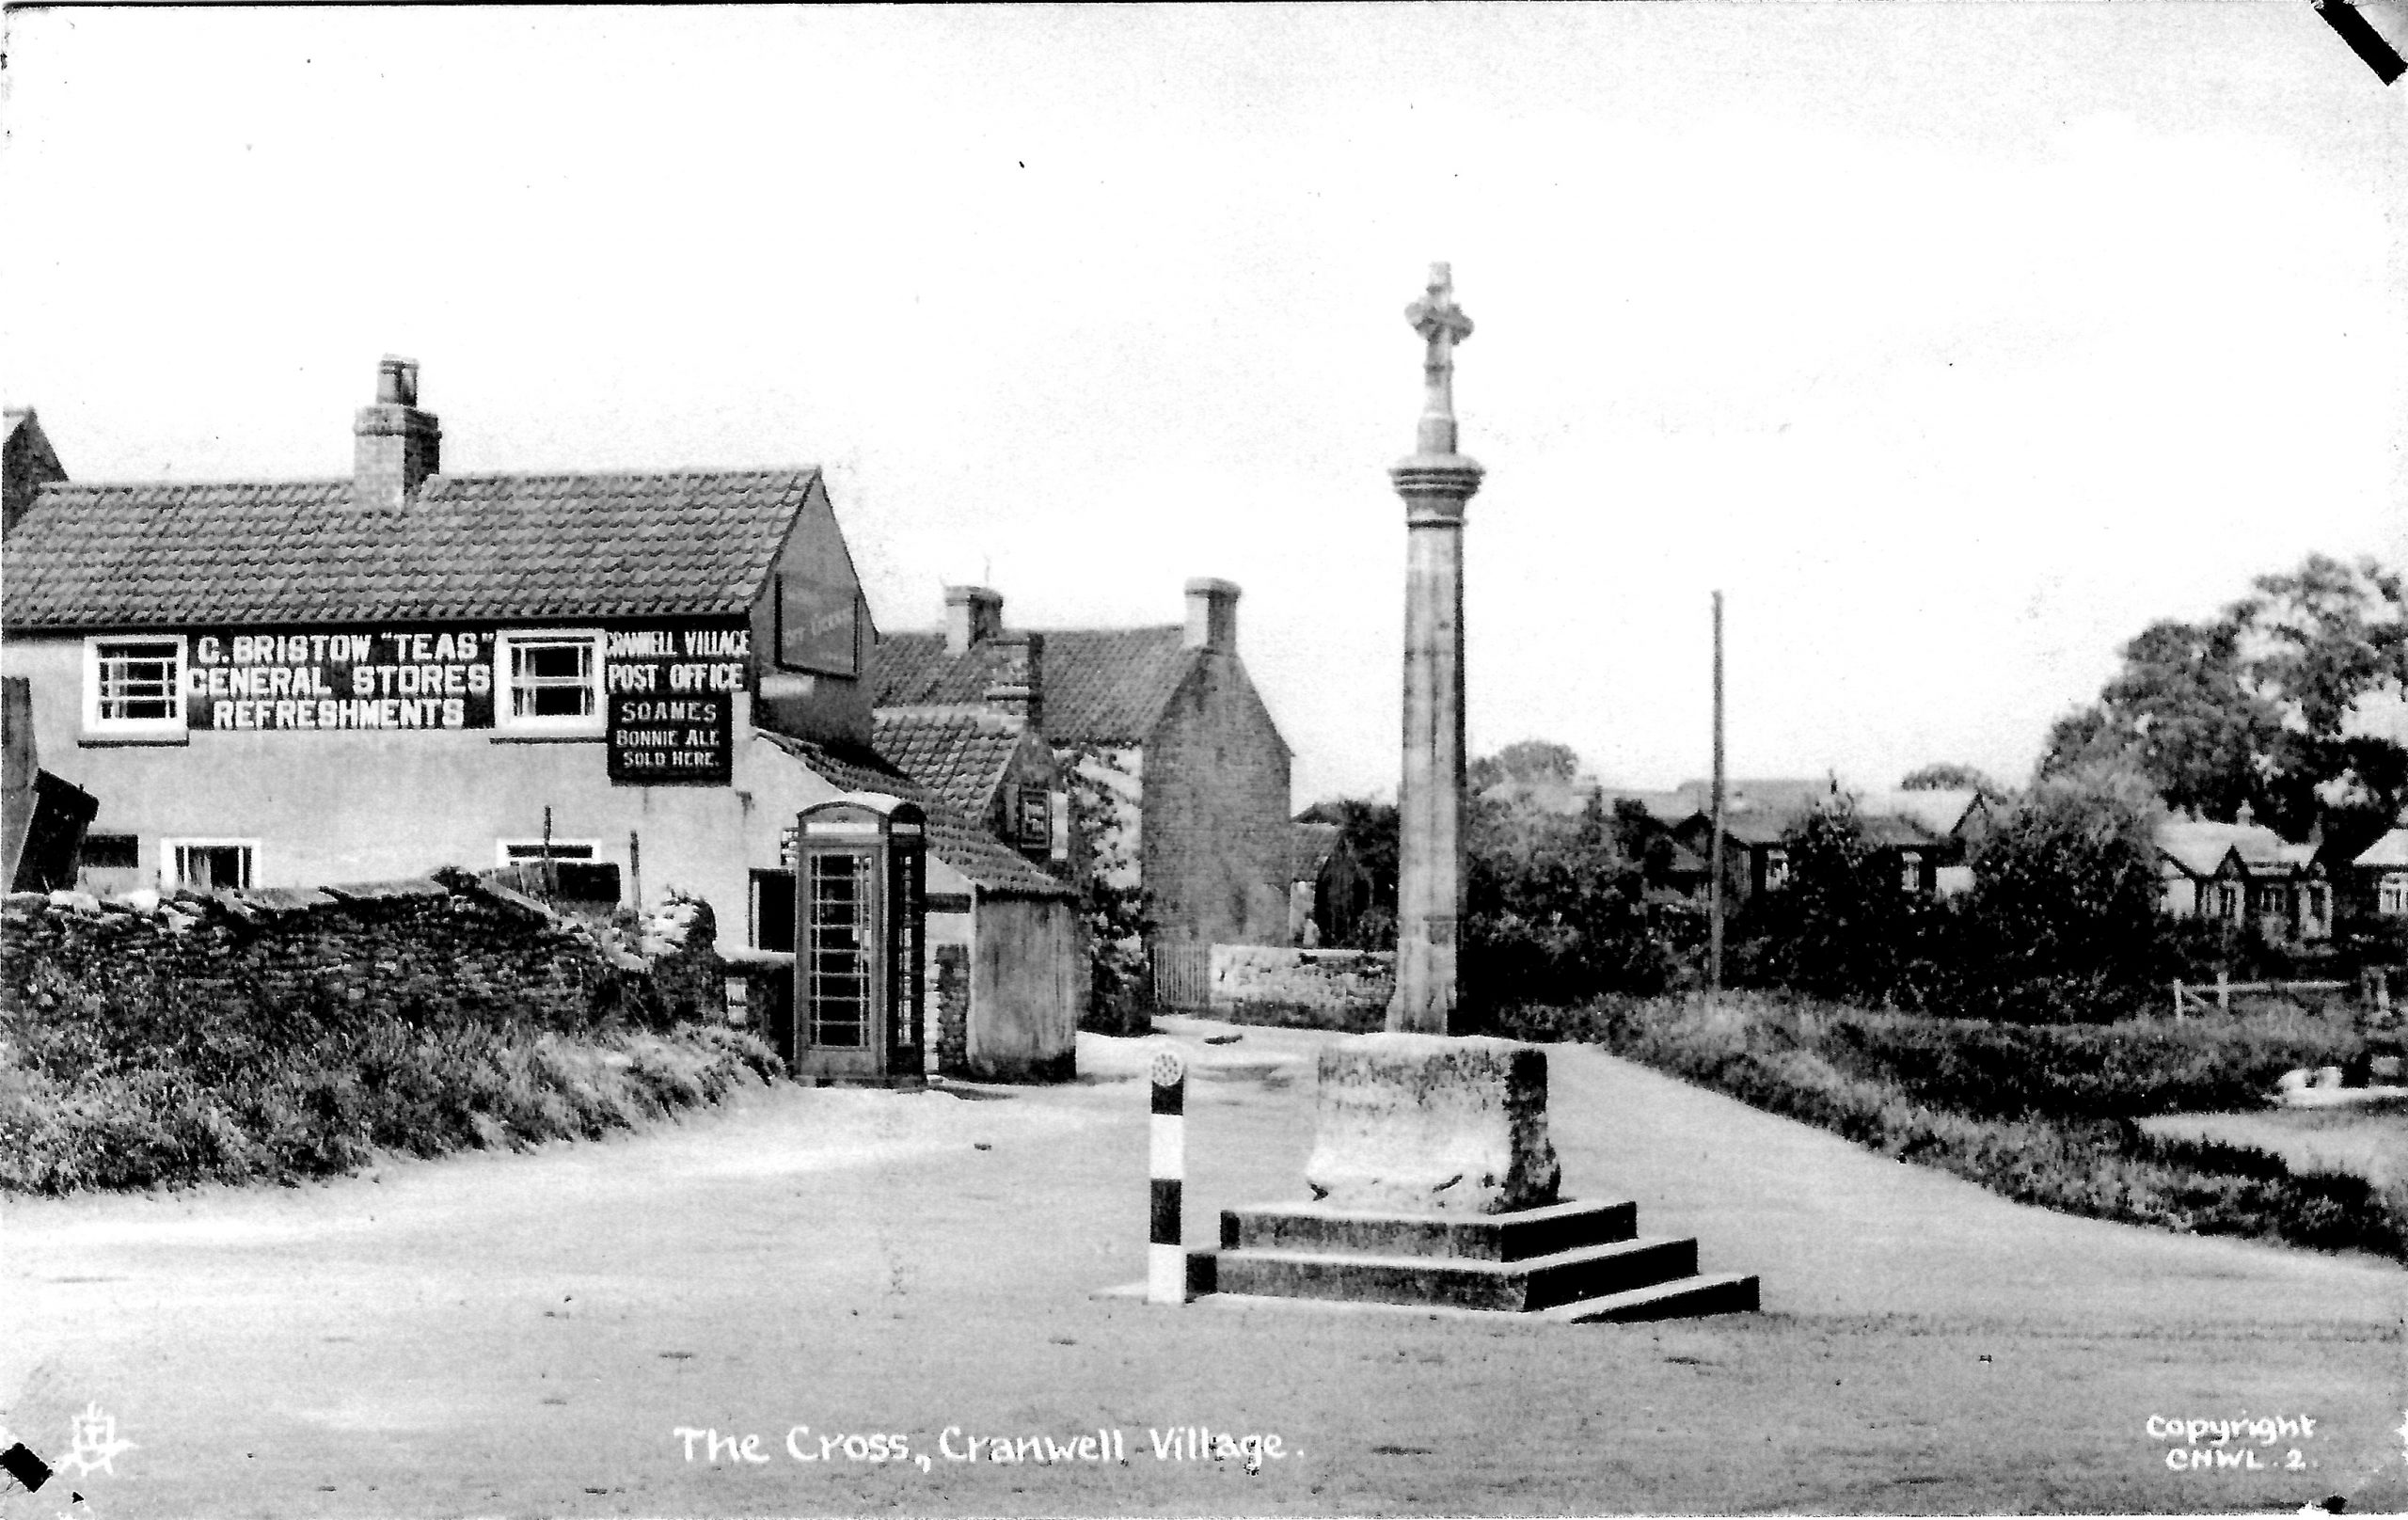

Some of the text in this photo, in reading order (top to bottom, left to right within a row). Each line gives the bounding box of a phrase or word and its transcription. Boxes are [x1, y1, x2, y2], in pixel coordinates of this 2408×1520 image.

[684, 630, 750, 657] VILLAGE
[188, 664, 490, 697] GENERAL STORES
[609, 663, 743, 692] POST OFFICE
[213, 698, 465, 727] REFRESHMENTS
[622, 702, 717, 723] SOAMES
[616, 729, 720, 748] BONNIE ALE
[623, 752, 666, 768] SOLD
